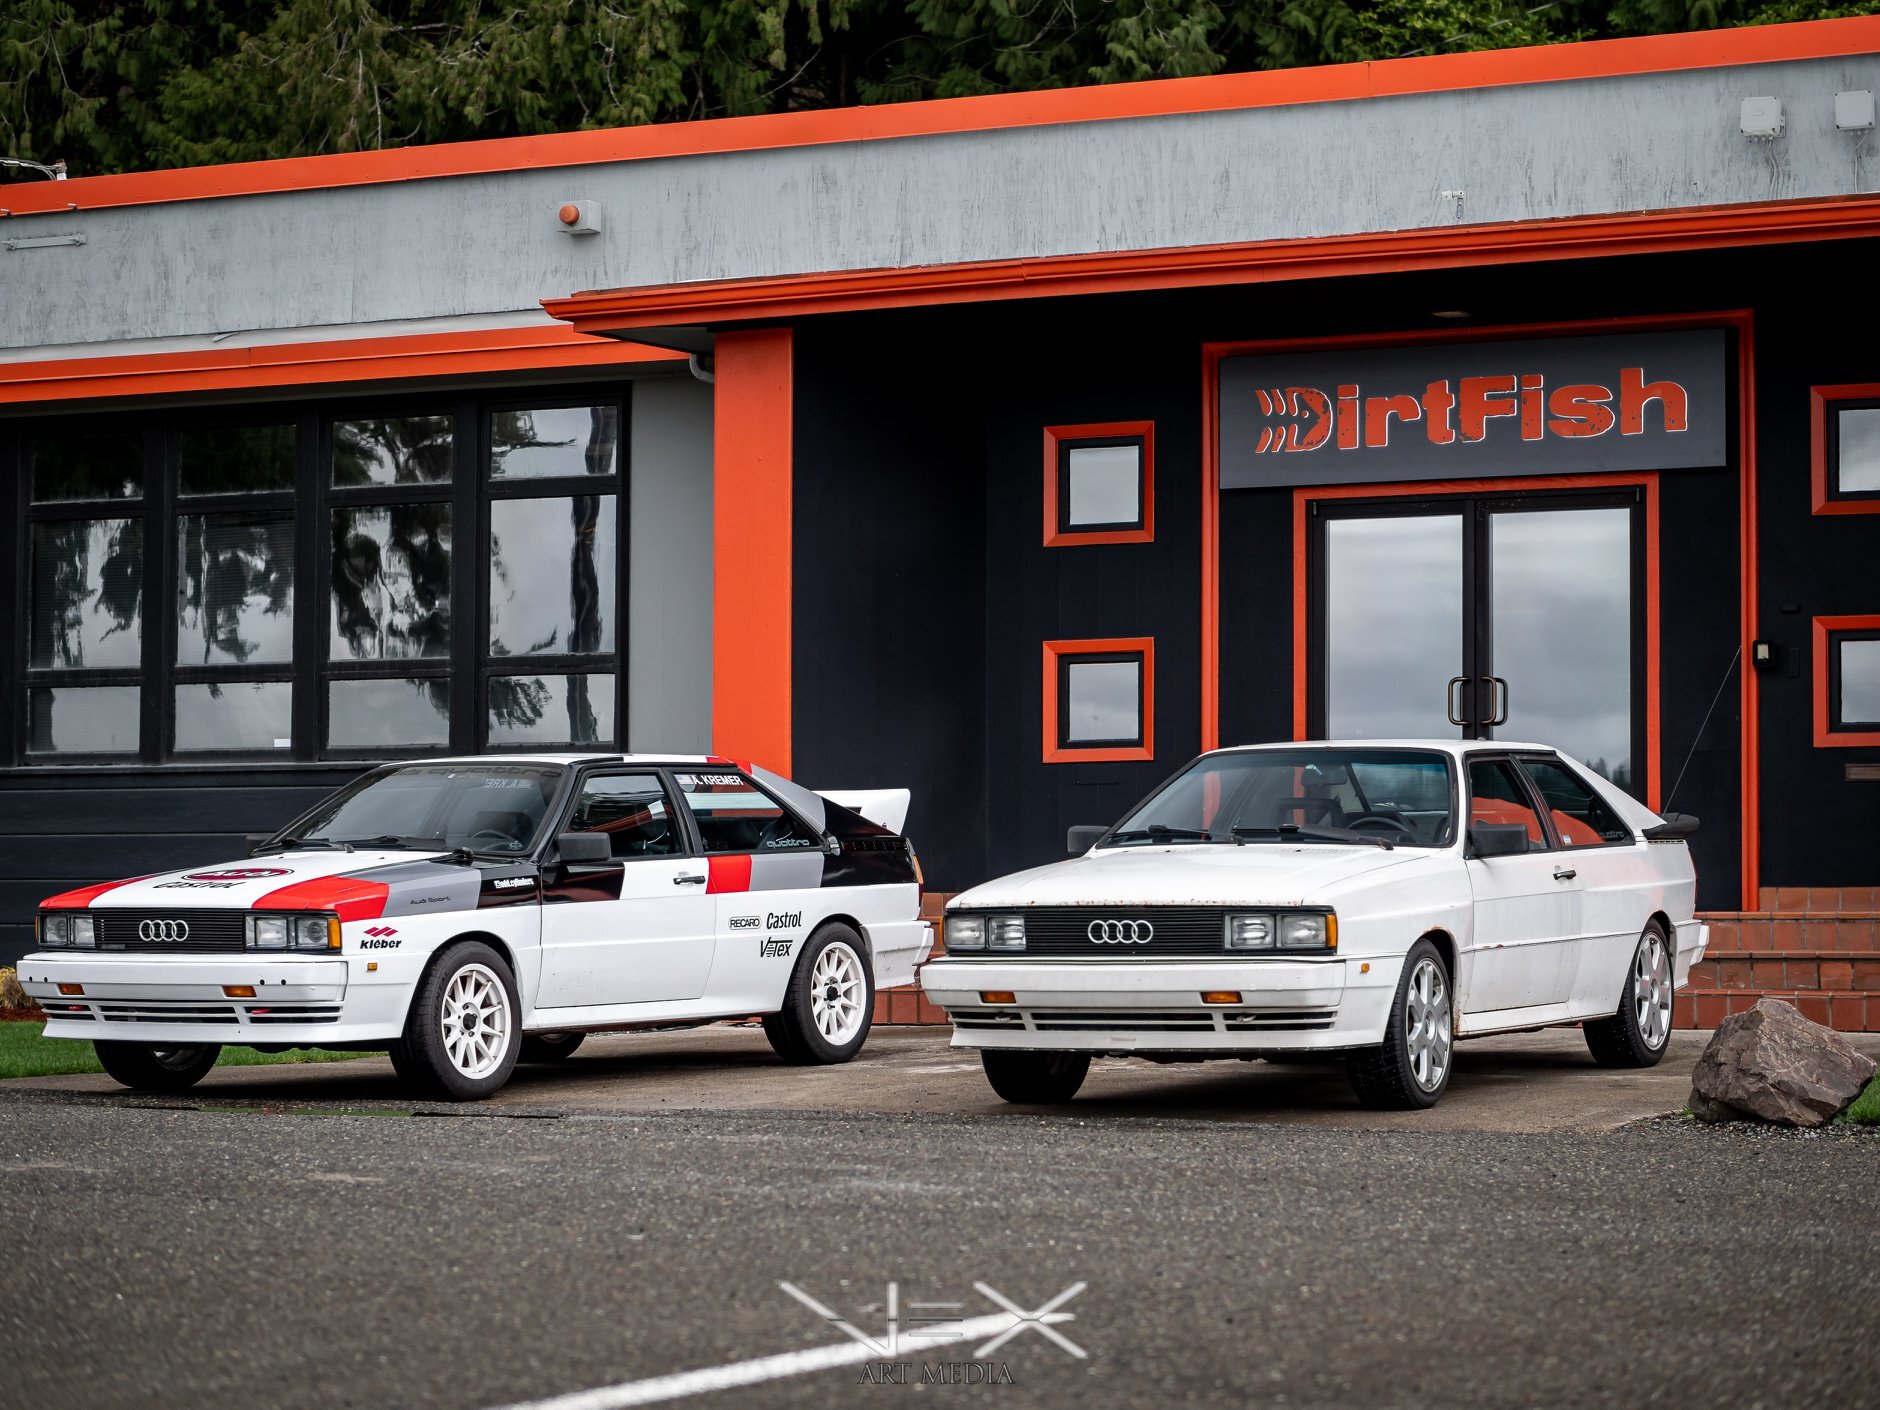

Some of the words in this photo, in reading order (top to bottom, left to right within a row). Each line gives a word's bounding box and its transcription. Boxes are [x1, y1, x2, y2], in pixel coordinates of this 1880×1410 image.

[1255, 367, 1688, 454] DirtFish
[704, 775, 744, 786] KREMER
[766, 838, 810, 848] quattro
[428, 896, 451, 904] Sport
[730, 918, 760, 928] RECARO
[766, 911, 802, 930] Castrol
